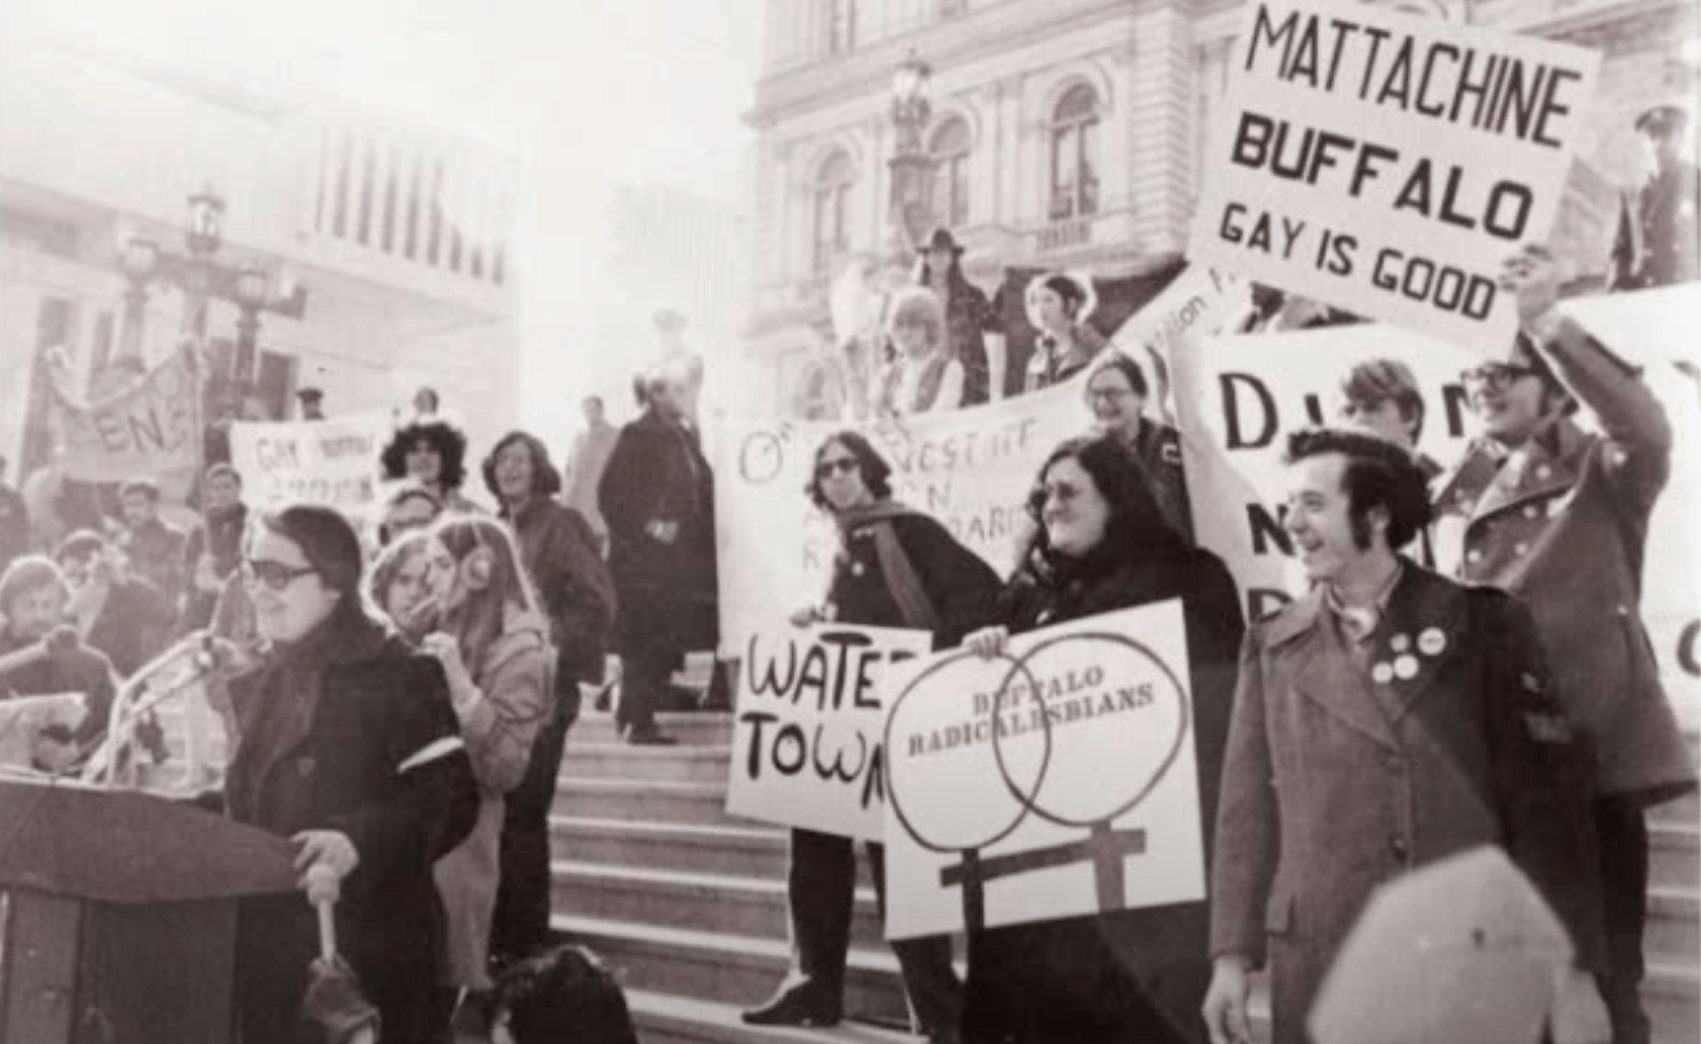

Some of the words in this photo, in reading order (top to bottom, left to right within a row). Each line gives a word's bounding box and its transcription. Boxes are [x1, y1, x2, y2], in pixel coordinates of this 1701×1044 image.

[1245, 3, 1582, 148] MATTACHINE
[1231, 111, 1534, 241] BUFFALO
[1219, 202, 1306, 260] GAY
[1316, 229, 1358, 277] IS
[1372, 248, 1497, 325] GOOD
[749, 631, 918, 711] WATE
[973, 664, 1104, 717] BUFFALO
